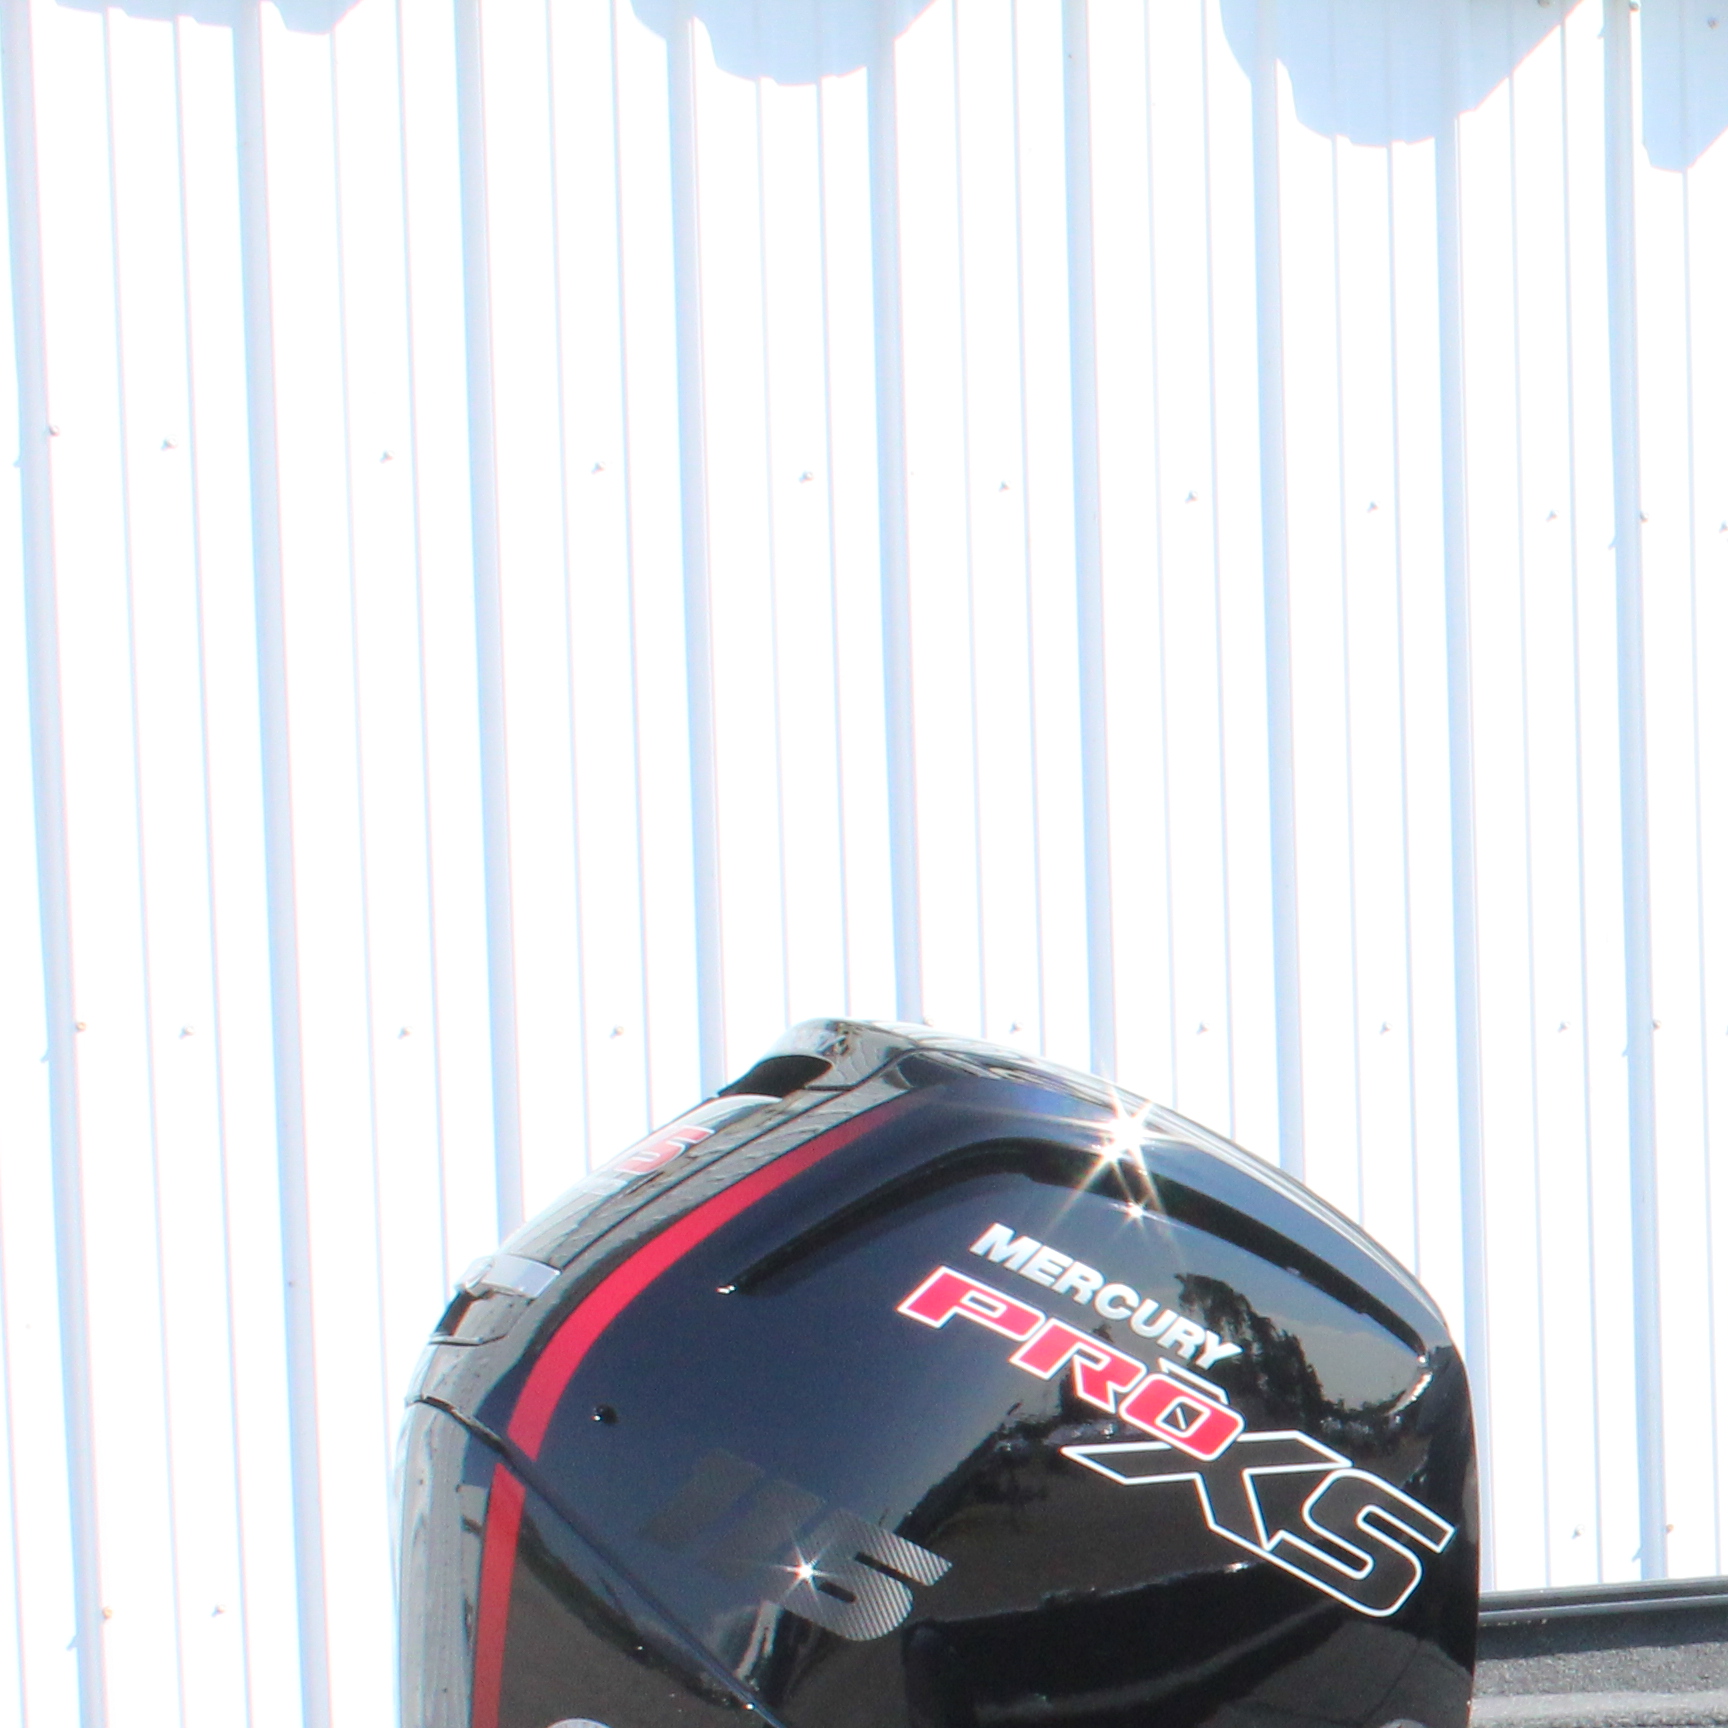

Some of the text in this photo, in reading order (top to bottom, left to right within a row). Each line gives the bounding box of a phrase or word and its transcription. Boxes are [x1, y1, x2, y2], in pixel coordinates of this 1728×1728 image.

[969, 1222, 1243, 1370] MERCURY
[897, 1265, 1456, 1618] PRO XS
